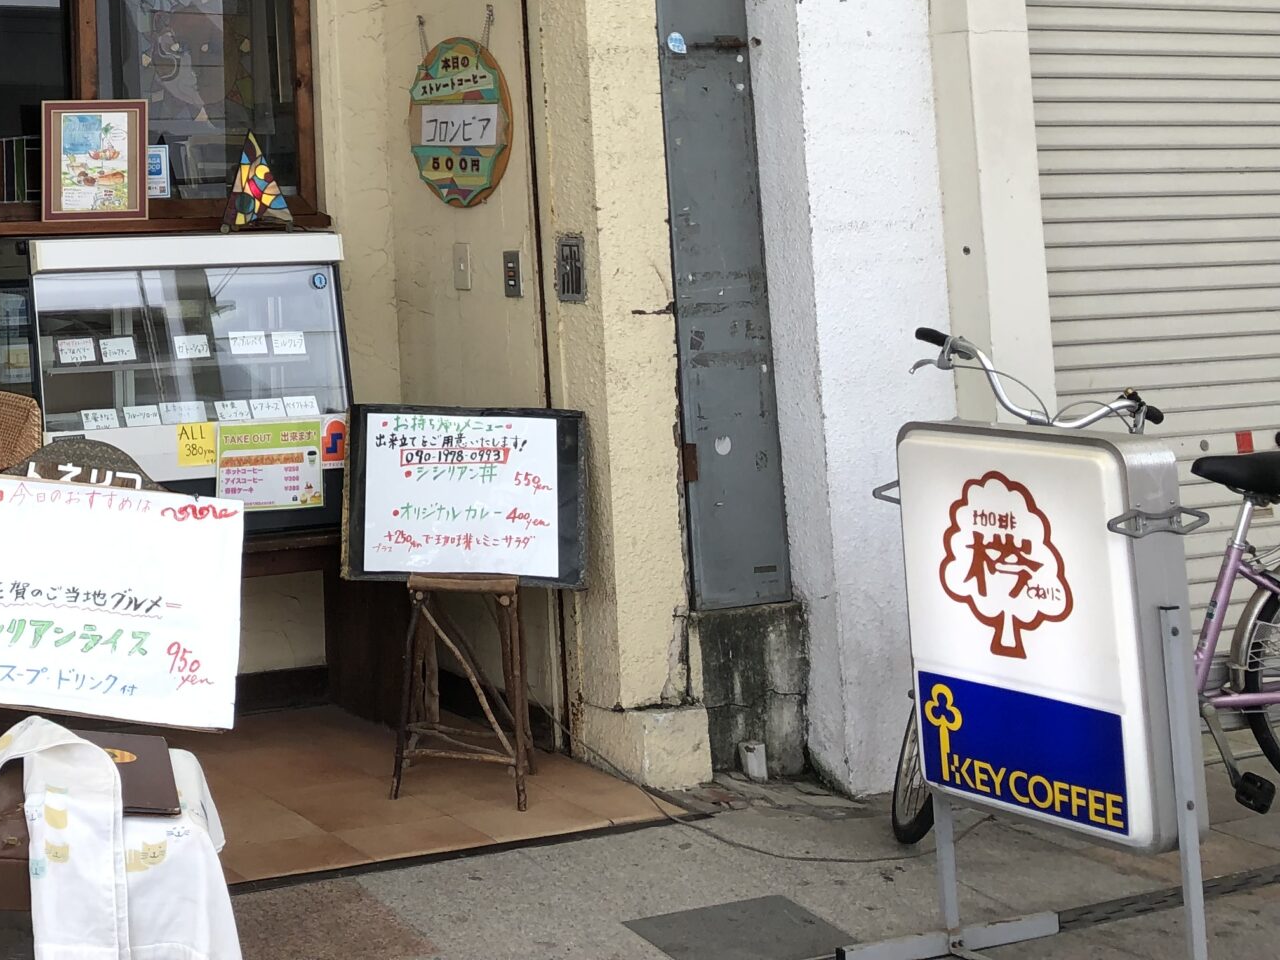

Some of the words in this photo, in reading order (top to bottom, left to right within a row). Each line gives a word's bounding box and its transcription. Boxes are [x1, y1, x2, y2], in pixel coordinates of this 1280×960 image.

[441, 55, 470, 72] 本日の
[421, 74, 488, 96] ストレートコーヒー
[426, 116, 491, 142] コロンビア
[432, 157, 481, 172] 500円
[178, 425, 206, 441] ALL
[224, 434, 250, 444] TAKE
[252, 433, 272, 443] OUT
[405, 449, 501, 463] 090-1978-0993
[225, 477, 264, 485] アイスコーヒー
[8, 483, 152, 512] 今日のおすすめは
[166, 641, 201, 674] 950
[947, 752, 1008, 797] KEY
[1009, 773, 1125, 829] COFFEE
